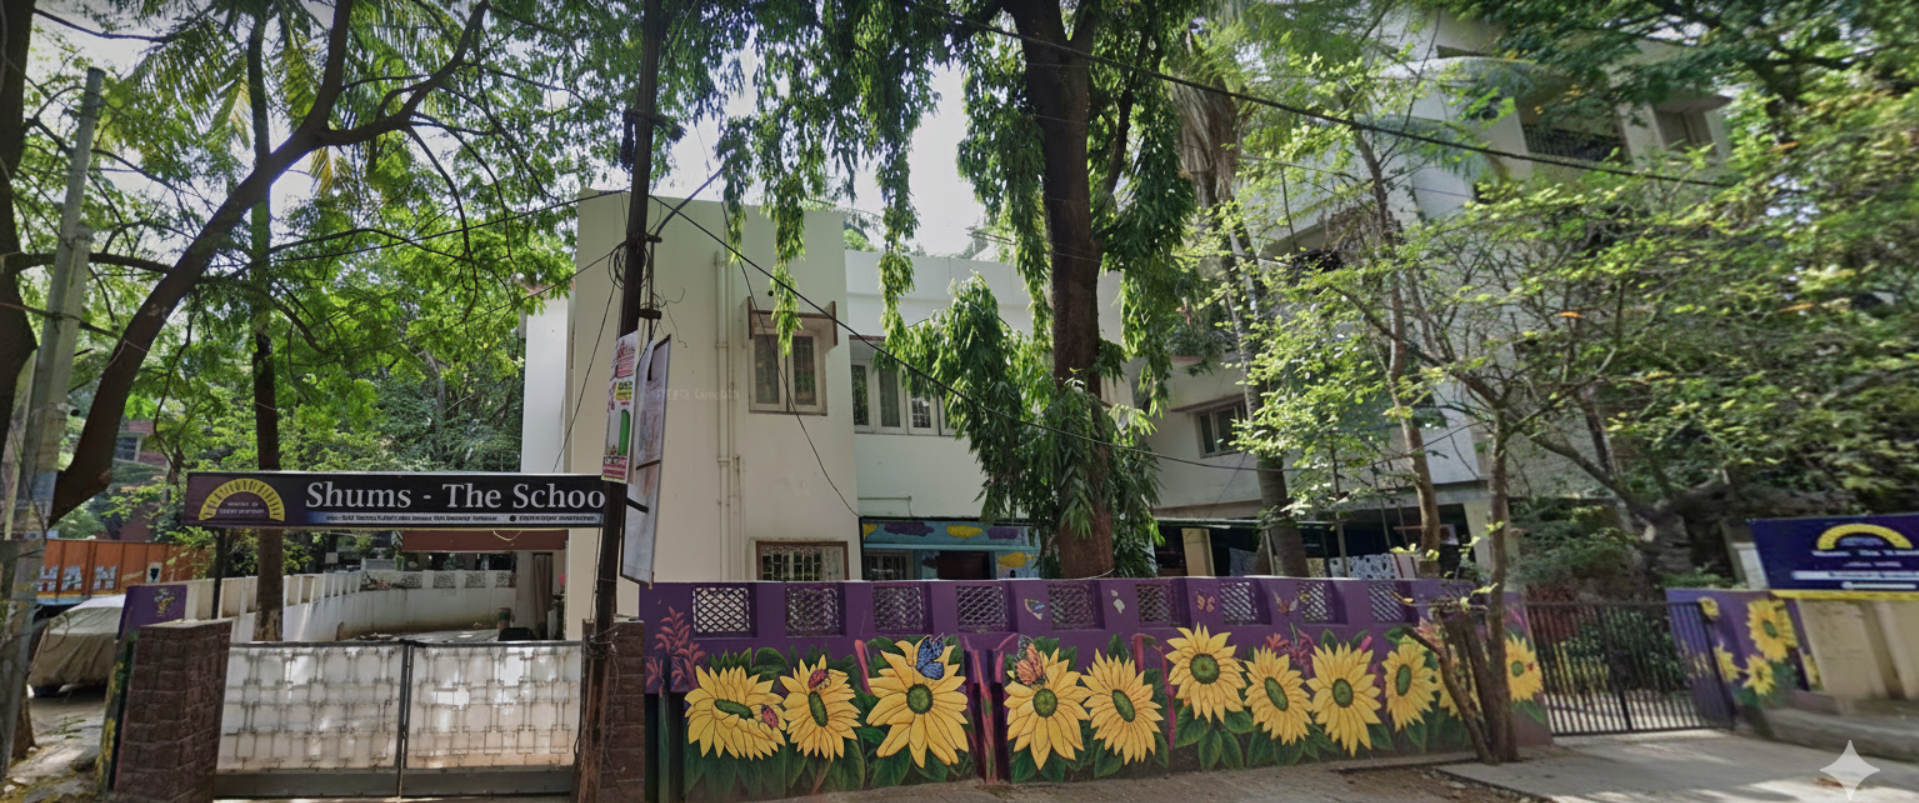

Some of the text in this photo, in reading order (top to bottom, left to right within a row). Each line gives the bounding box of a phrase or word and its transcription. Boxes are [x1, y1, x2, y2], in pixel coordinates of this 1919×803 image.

[306, 481, 412, 508] Shums
[442, 483, 502, 508] The
[512, 483, 606, 509] Schoo
